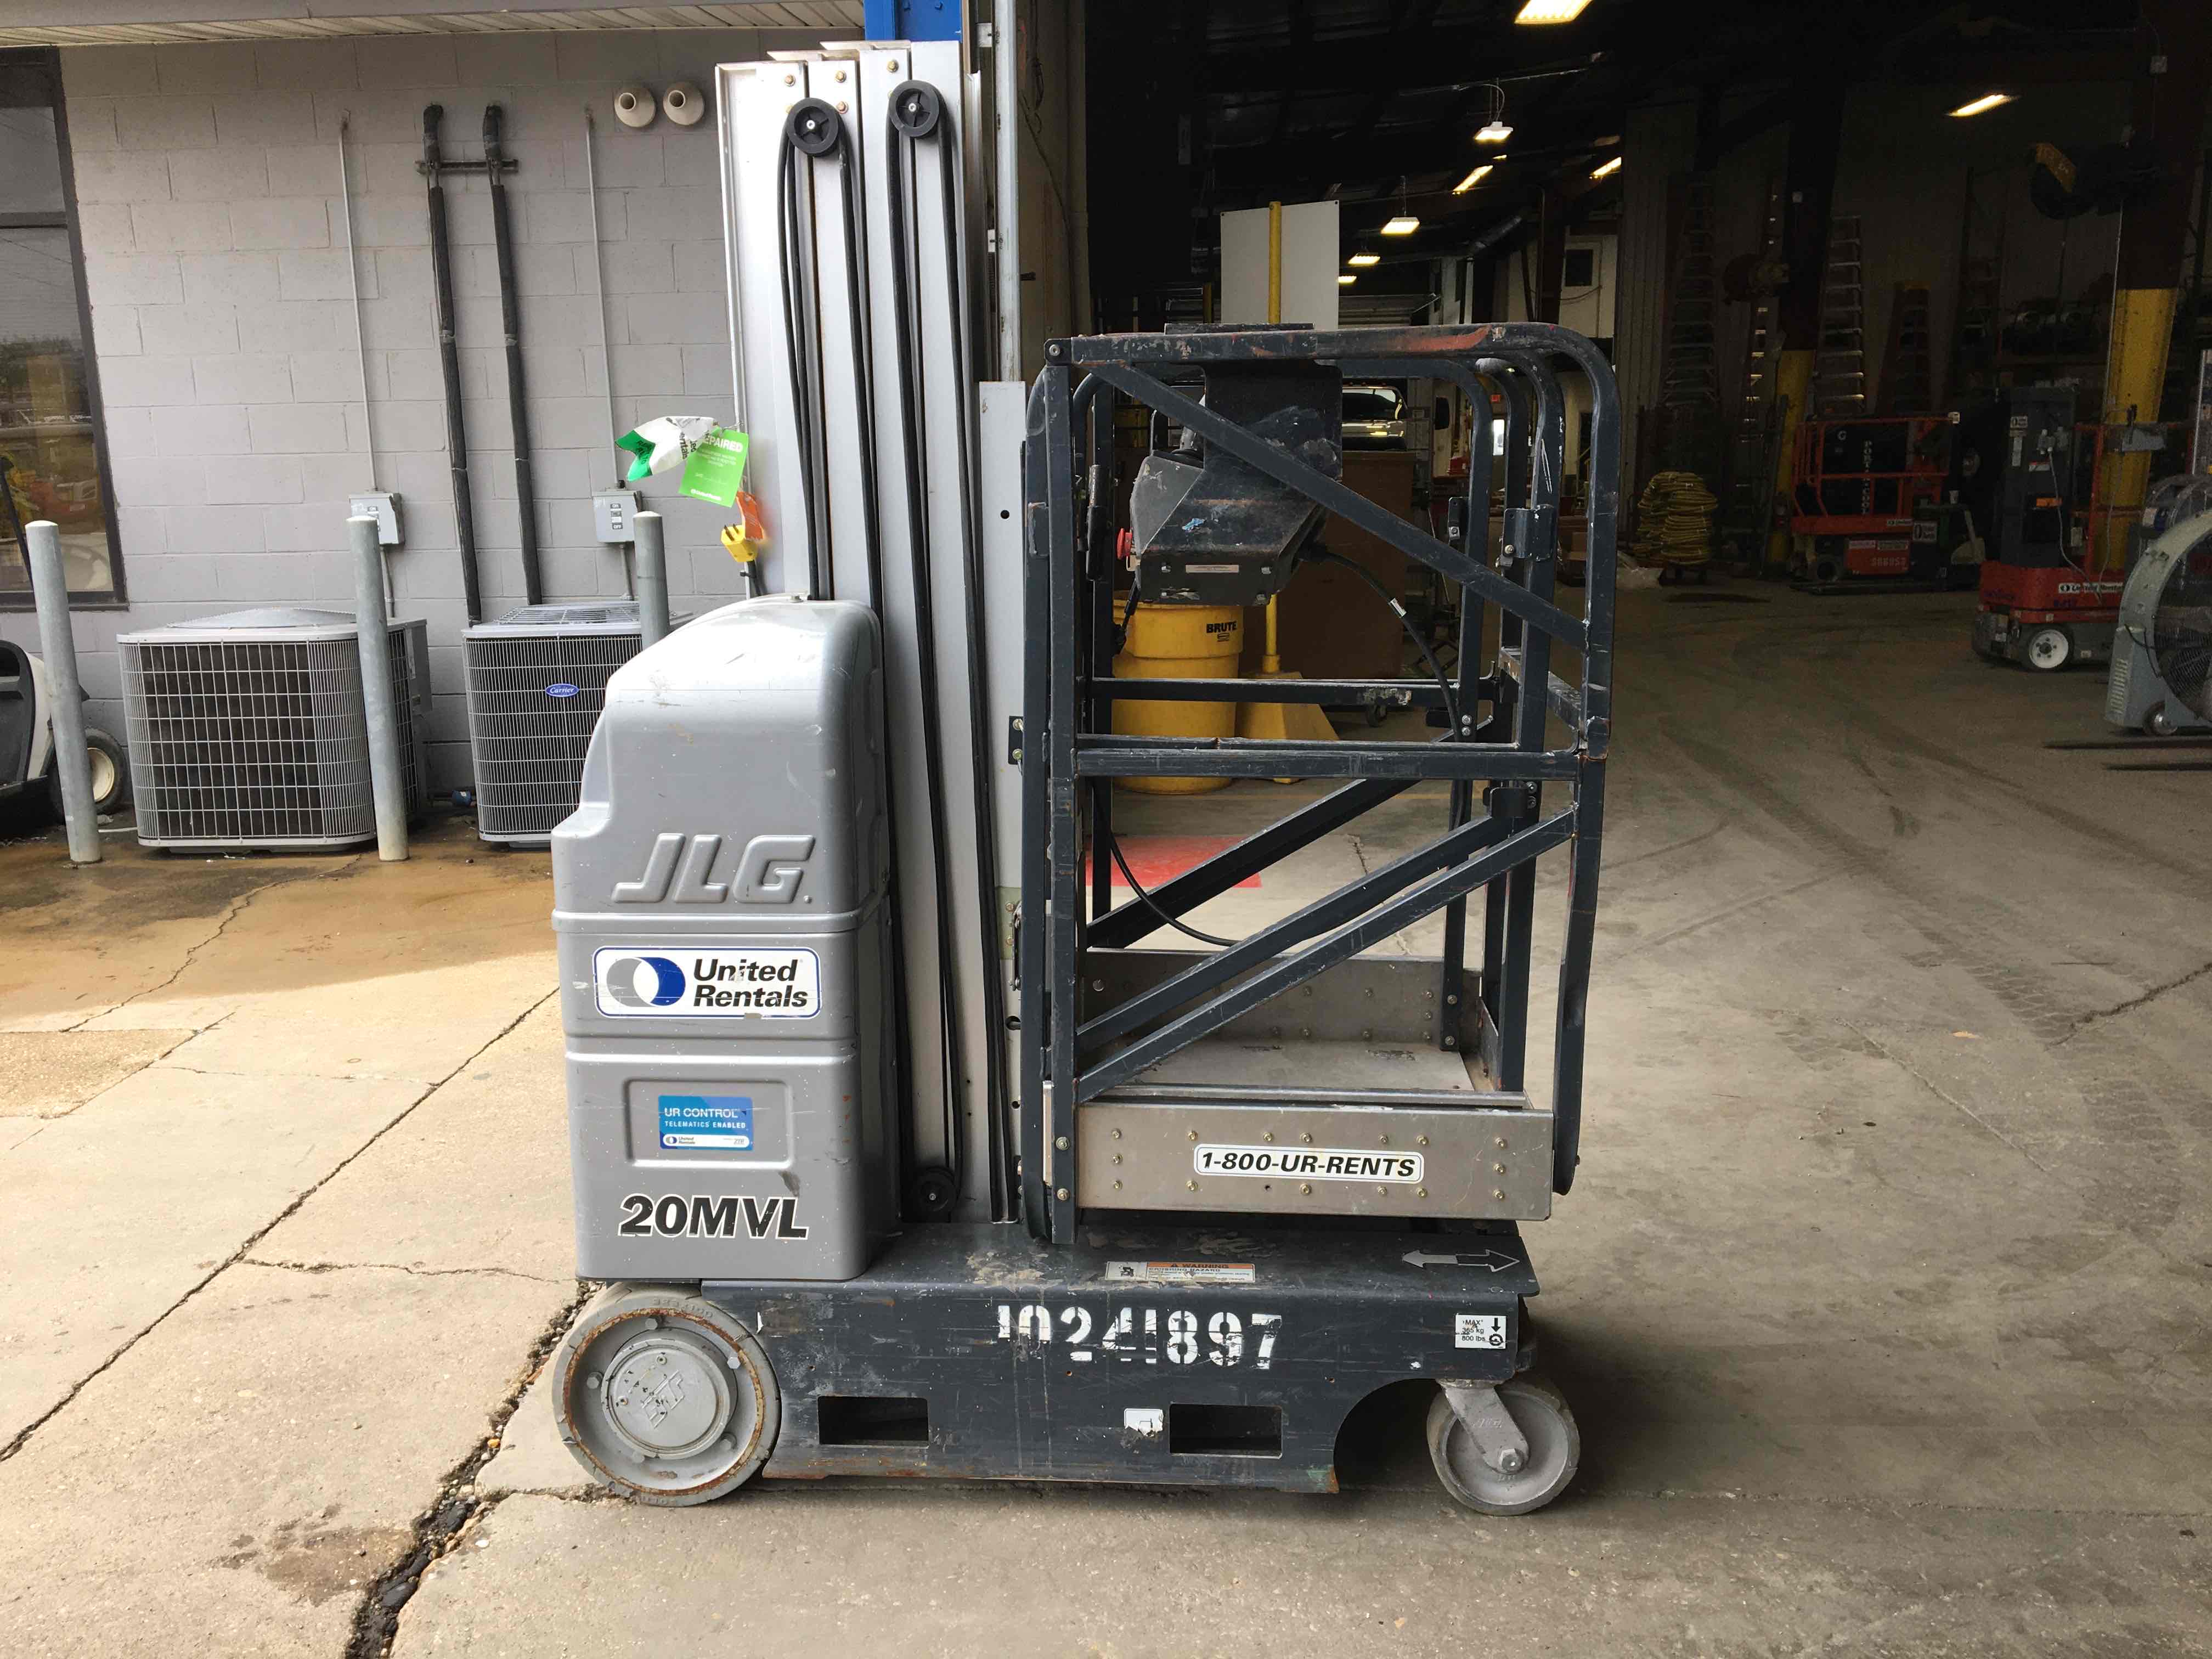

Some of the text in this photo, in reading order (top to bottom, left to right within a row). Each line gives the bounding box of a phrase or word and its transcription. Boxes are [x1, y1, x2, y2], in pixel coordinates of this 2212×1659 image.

[704, 435, 743, 453] EPAIRED
[1206, 620, 1237, 633] BRUTE
[693, 959, 798, 981] United
[693, 985, 808, 1007] Rentals
[664, 1107, 738, 1118] UR CONTROL
[1201, 1152, 1415, 1177] 1-800-UR-RENTS
[618, 1193, 809, 1240] 20MVL
